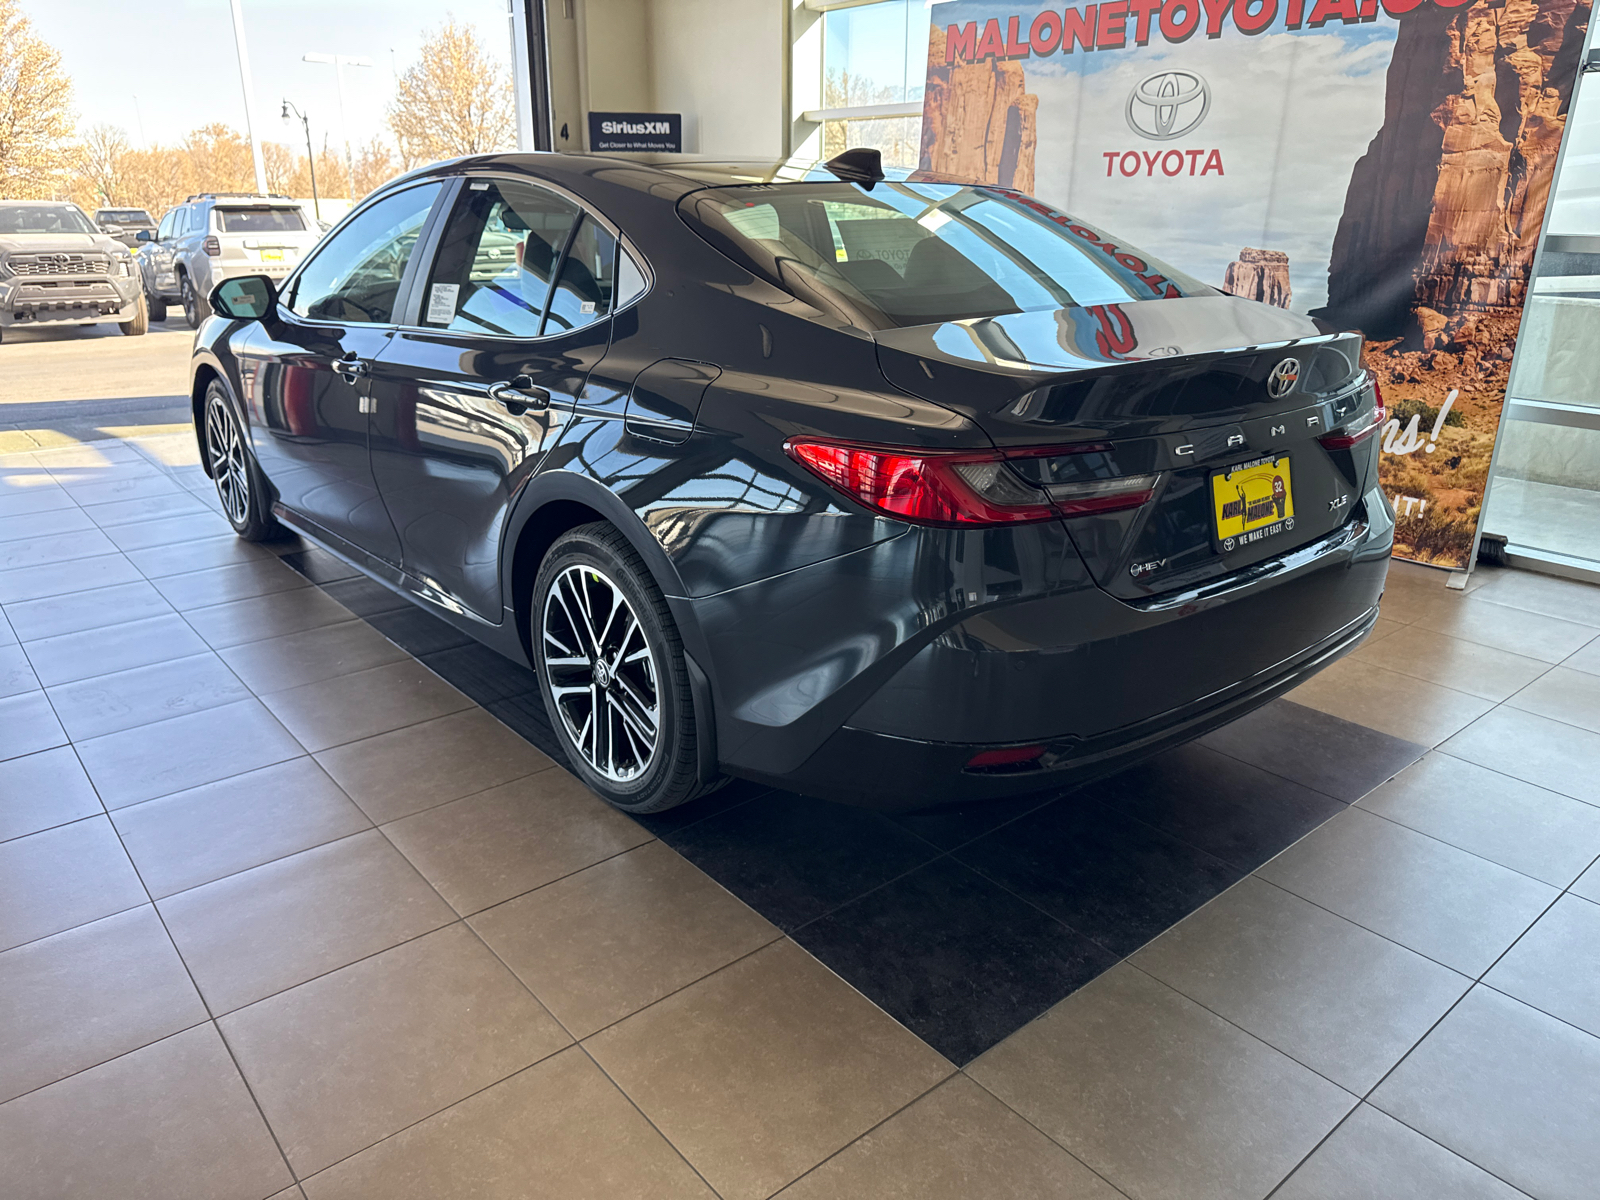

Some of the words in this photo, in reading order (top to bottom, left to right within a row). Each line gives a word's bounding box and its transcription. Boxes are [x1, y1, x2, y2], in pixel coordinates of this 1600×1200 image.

[560, 122, 569, 141] 4
[601, 121, 671, 134] SiriusXM
[1103, 149, 1224, 177] TOYOTA
[1231, 464, 1243, 473] KARL
[1243, 459, 1260, 469] MALONE
[1261, 455, 1275, 465] TOYOTA
[1274, 481, 1283, 493] 32
[1222, 499, 1243, 520] KARL
[1246, 501, 1275, 523] MALONE
[1328, 494, 1347, 512] XLE
[1239, 534, 1248, 545] WE
[1248, 530, 1263, 542] MAKE
[1263, 527, 1269, 537] IT
